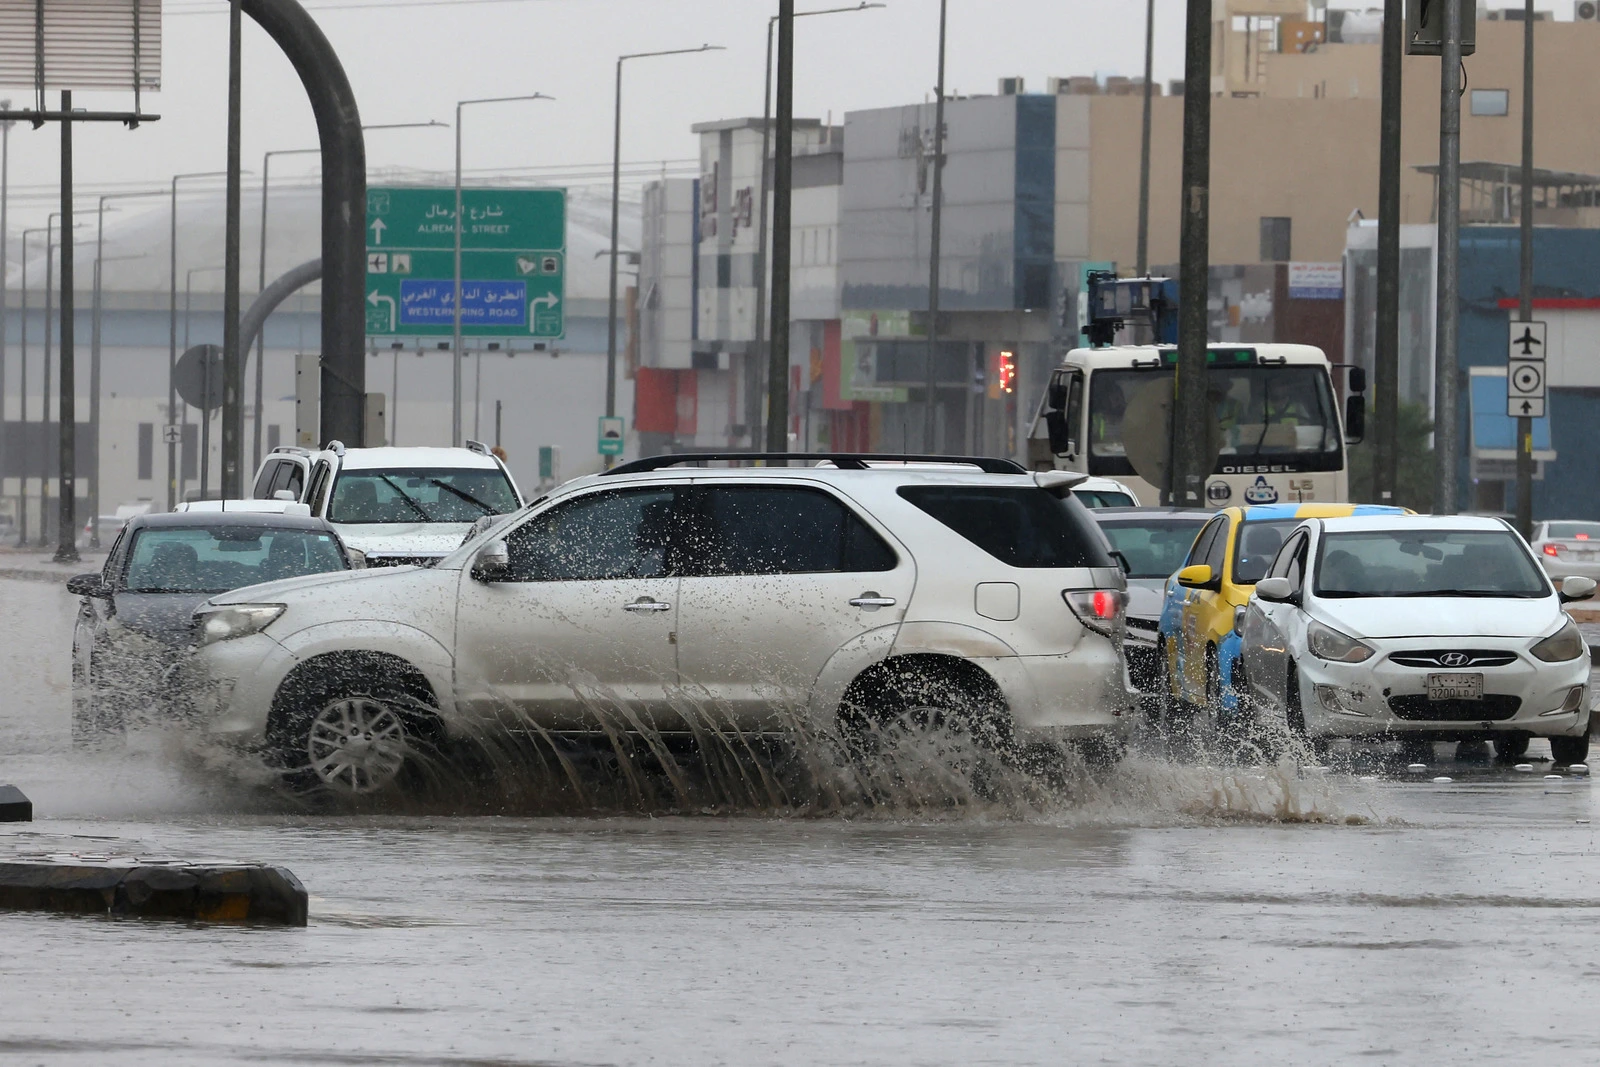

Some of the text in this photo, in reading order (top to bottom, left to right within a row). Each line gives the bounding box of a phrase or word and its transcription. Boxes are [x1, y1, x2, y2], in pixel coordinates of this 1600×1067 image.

[425, 203, 504, 220] شارع ارمال
[417, 224, 510, 233] ALREML STREET
[402, 288, 524, 306] الطريق الداري الغربي
[408, 307, 518, 317] WESTERN RING ROAD
[1222, 465, 1296, 473] DIESEL
[1431, 688, 1455, 699] 3200
